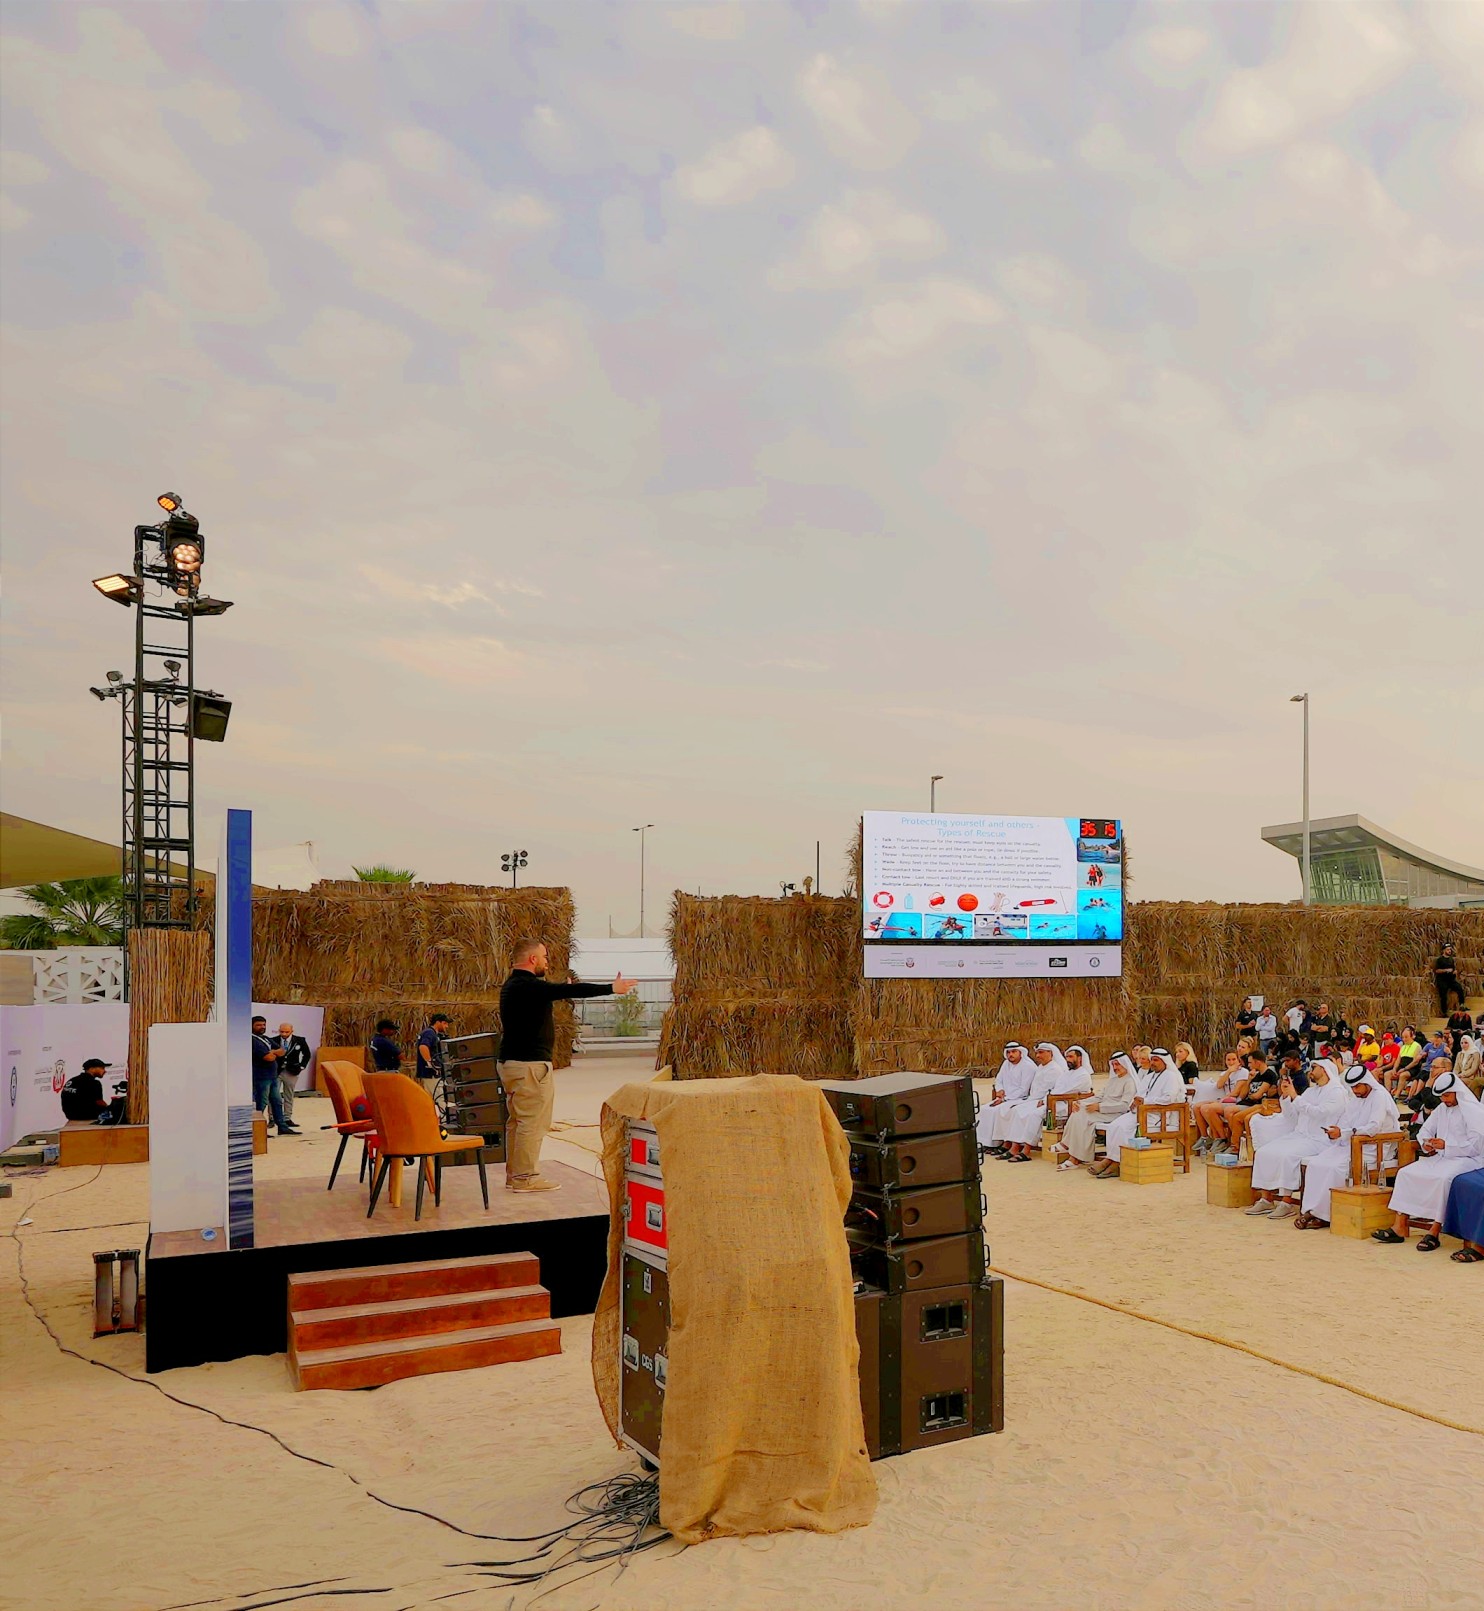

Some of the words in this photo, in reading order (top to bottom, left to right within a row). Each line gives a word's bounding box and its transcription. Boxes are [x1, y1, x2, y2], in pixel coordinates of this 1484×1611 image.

[901, 816, 948, 827] Protecting
[949, 817, 986, 828] yourself
[988, 819, 1004, 828] and
[1006, 820, 1034, 829] others
[937, 828, 961, 837] Types
[963, 828, 974, 837] of
[976, 829, 1006, 838] Rescue
[1081, 823, 1097, 836] 35
[1104, 823, 1116, 838] 15
